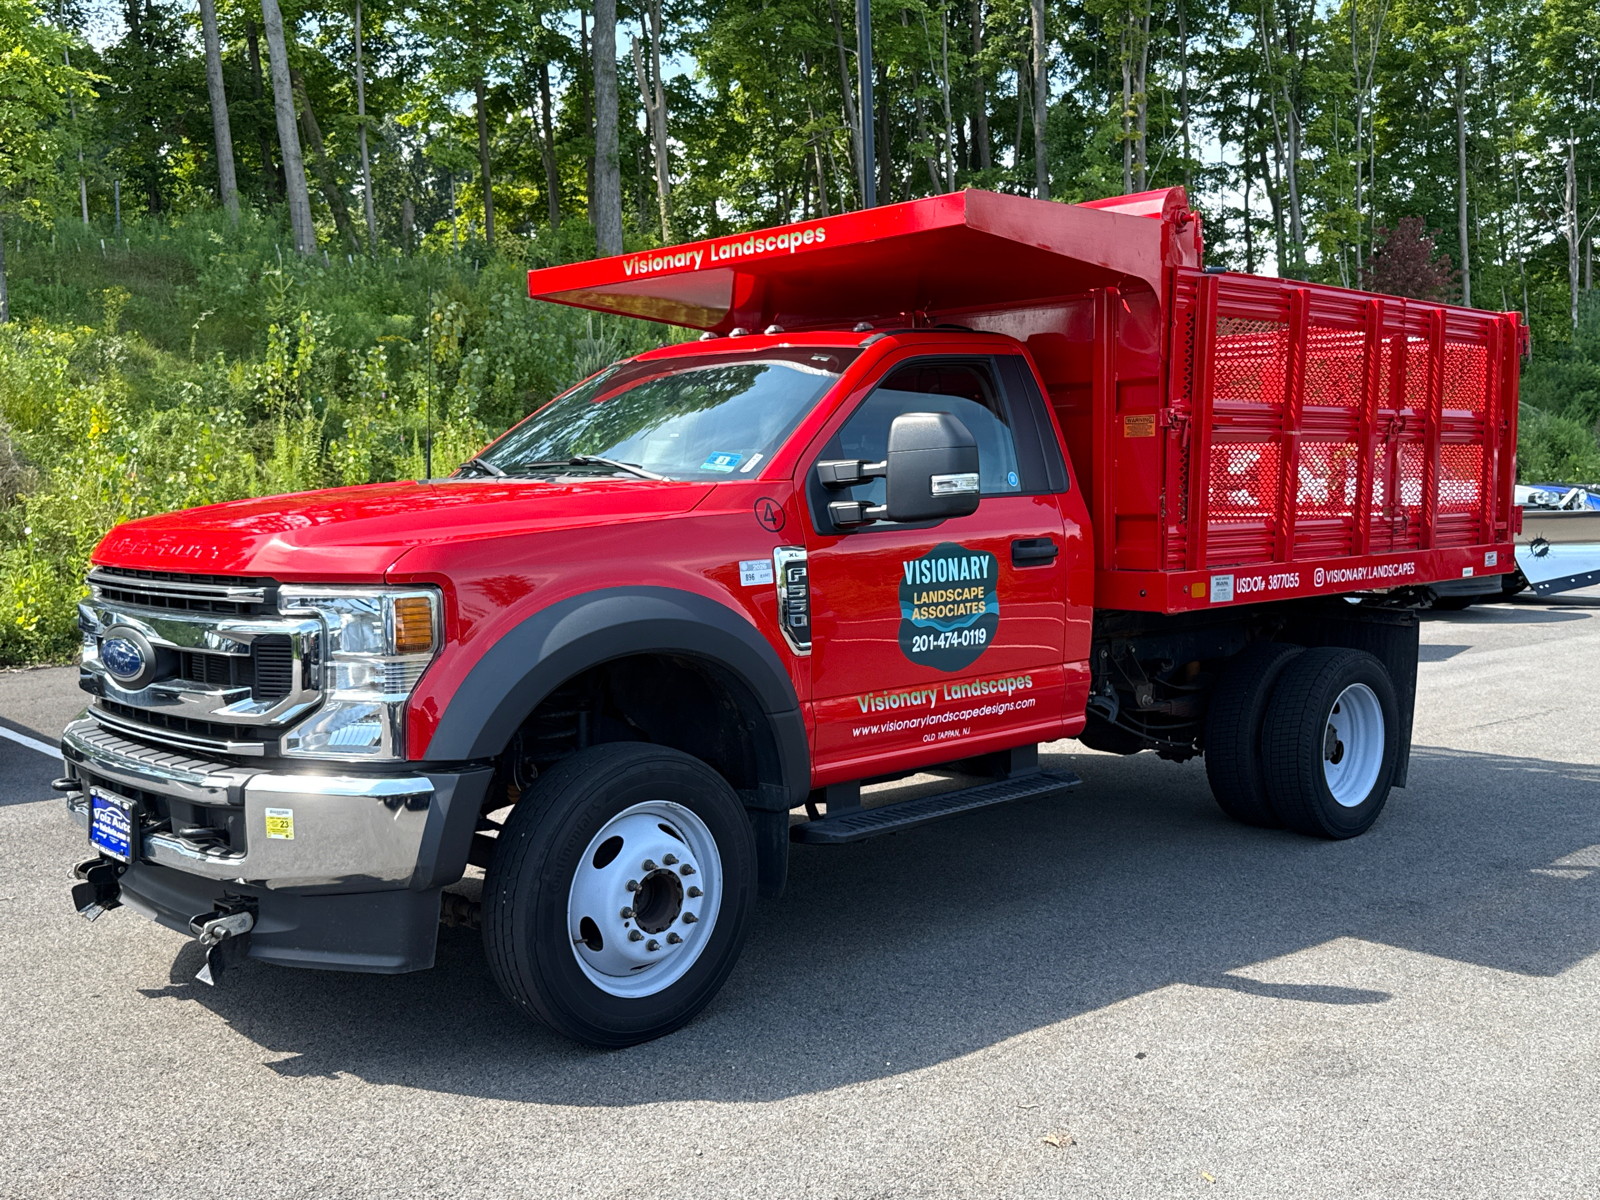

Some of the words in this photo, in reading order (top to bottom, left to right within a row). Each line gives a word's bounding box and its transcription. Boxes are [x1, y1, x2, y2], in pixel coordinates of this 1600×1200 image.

[623, 249, 703, 276] Visionary
[710, 227, 826, 262] Landscapes
[763, 502, 777, 525] 4
[902, 555, 990, 585] VISIONARY
[1325, 562, 1415, 583] VISIONARY.LANDSCAPES
[1236, 576, 1266, 593] USDOT#
[1268, 572, 1300, 590] 3877055
[913, 586, 985, 605] LANDSCAPE
[911, 601, 986, 620] ASSOCIATES
[912, 628, 987, 652] 201-474-0119
[856, 688, 937, 713] Visionary
[944, 675, 1033, 701] Landscapes
[852, 698, 1036, 737] www.visionarylandscapedesigns.com
[922, 733, 936, 742] OLD
[962, 726, 971, 735] NJ
[93, 808, 111, 825] Volz
[279, 820, 289, 829] 23
[547, 811, 594, 895] Continental
